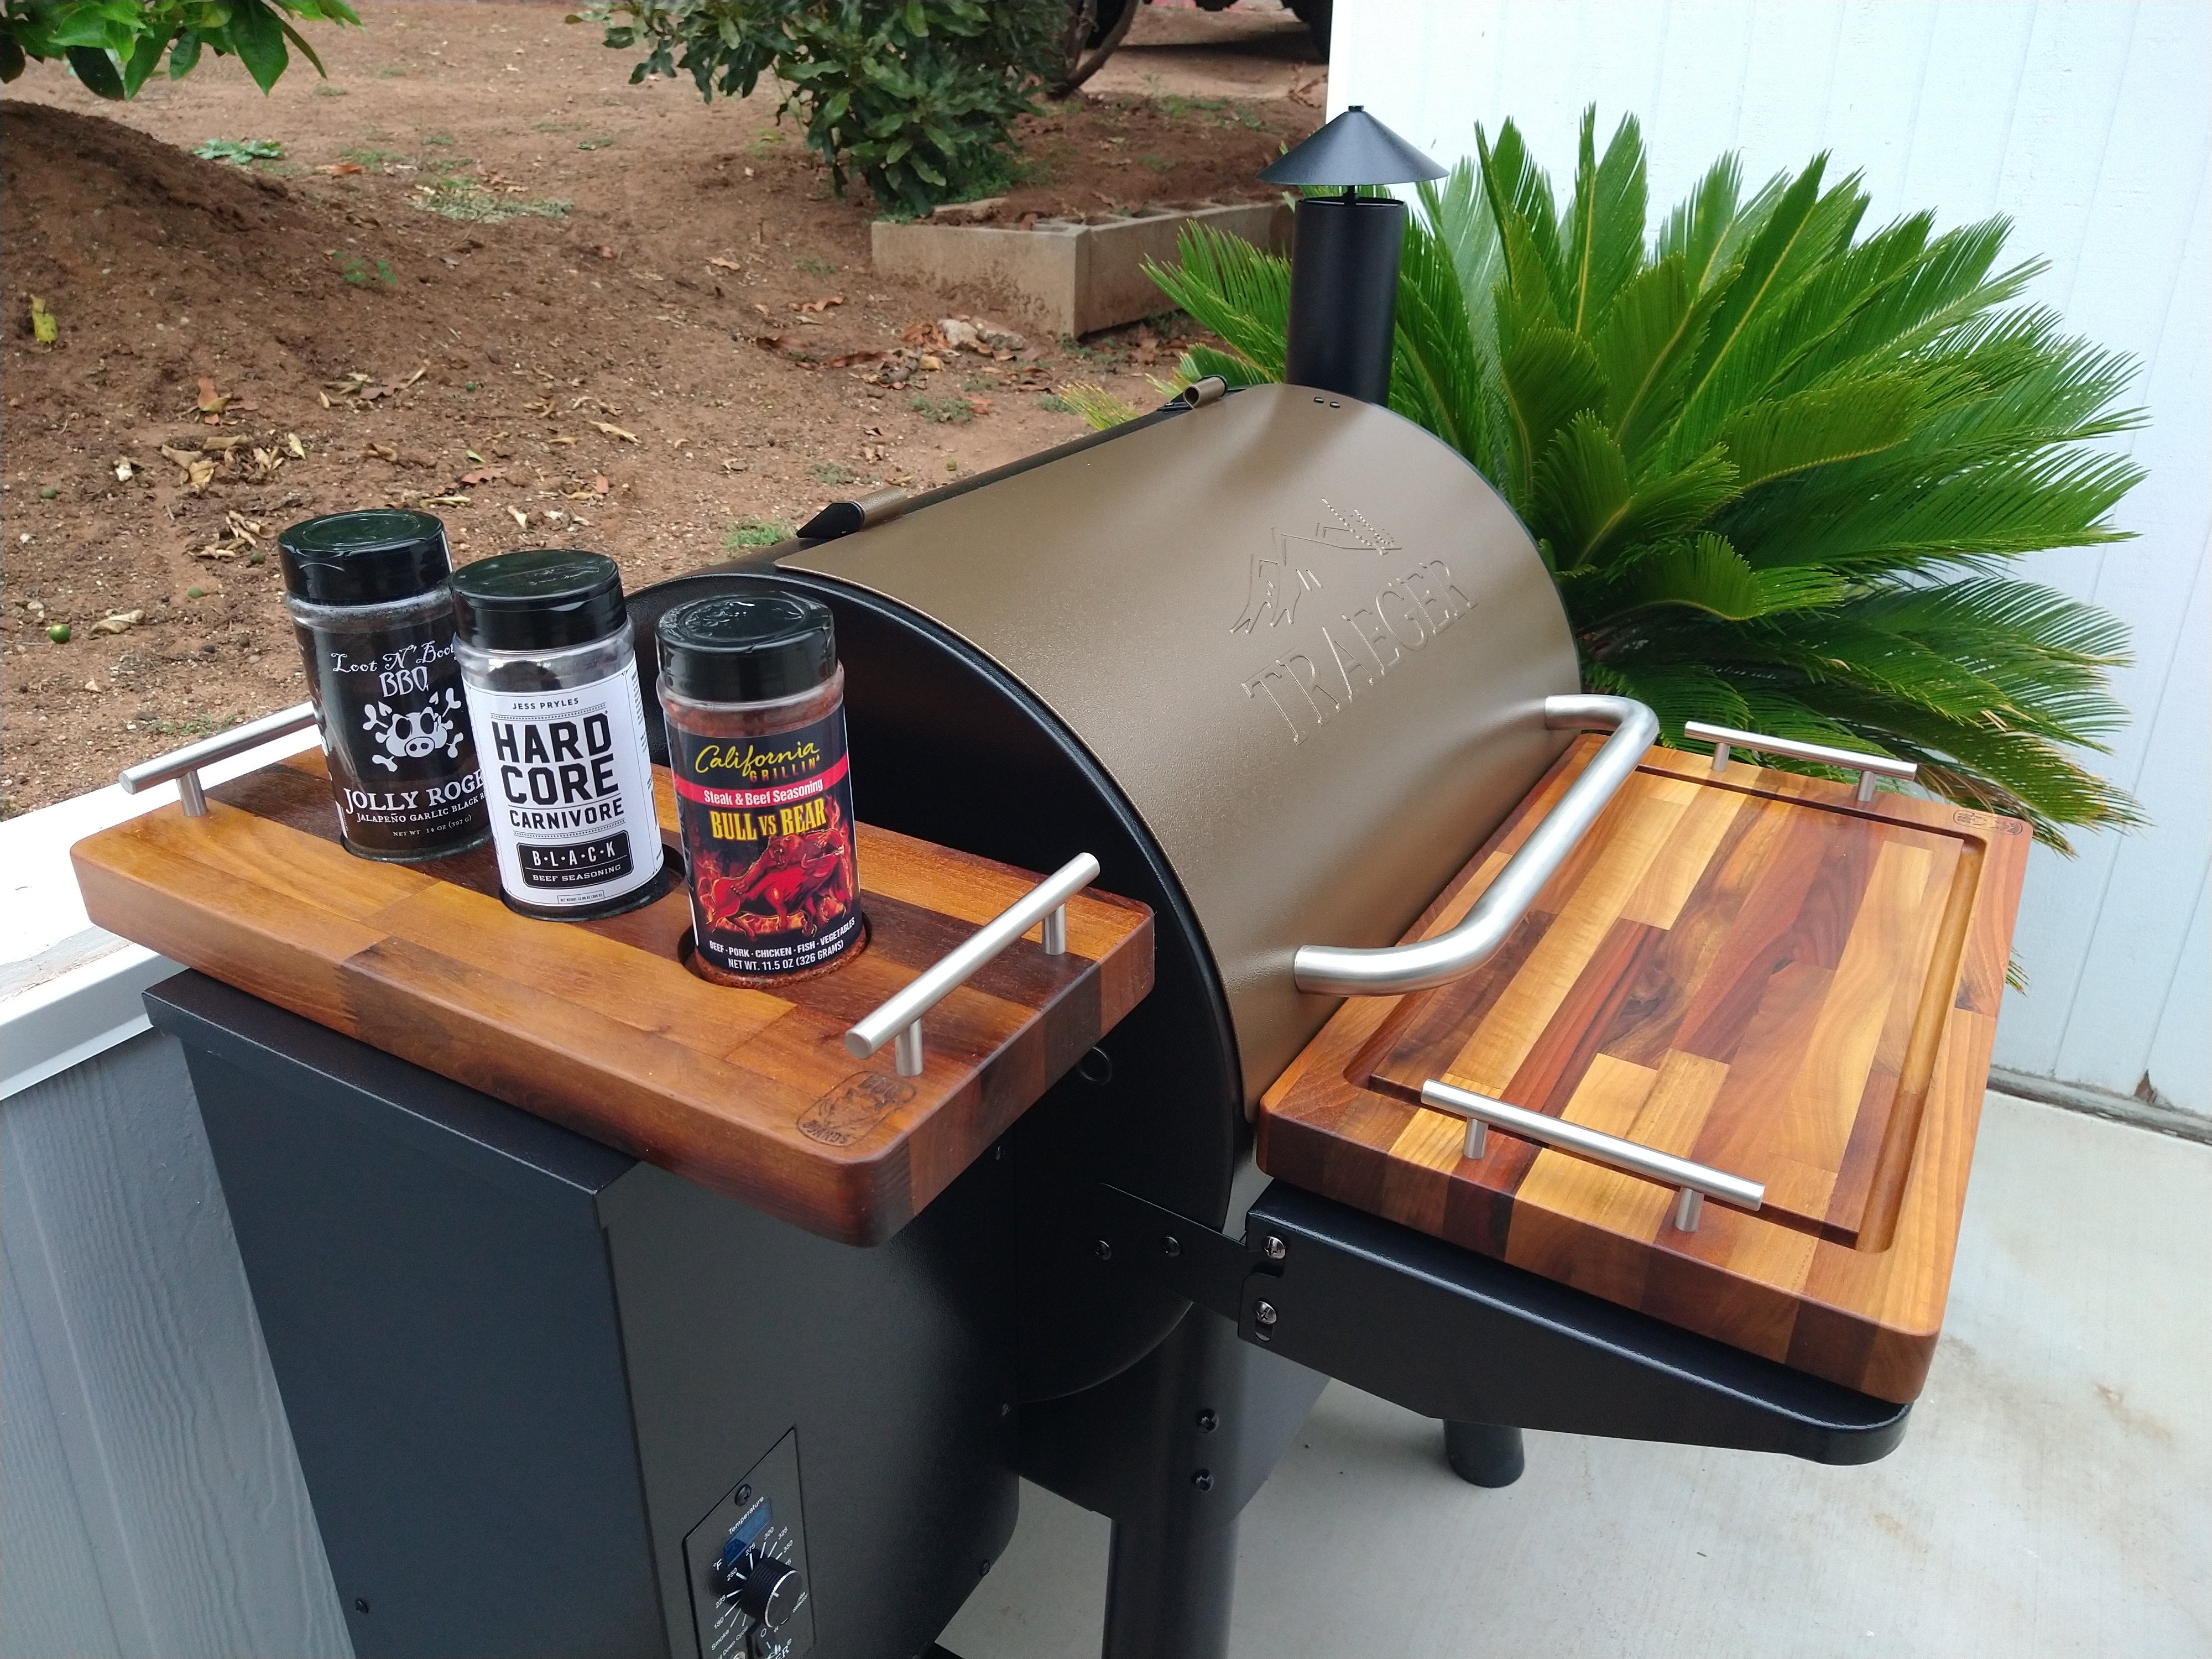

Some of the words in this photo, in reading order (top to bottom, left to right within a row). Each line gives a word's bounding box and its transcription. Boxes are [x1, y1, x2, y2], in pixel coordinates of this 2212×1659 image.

[331, 653, 377, 672] Loot
[416, 640, 458, 664] Boot
[1240, 559, 1478, 745] TRAEGER
[379, 666, 429, 697] BBQ
[540, 697, 579, 709] PRYLES
[491, 712, 612, 764] HARD
[695, 741, 820, 777] California
[343, 787, 419, 815] JOLLY
[426, 769, 484, 807] ROGE
[500, 753, 619, 805] CORE
[703, 790, 733, 806] Steak
[735, 793, 743, 806] &
[744, 790, 771, 806] Beef
[773, 779, 824, 802] Seasoning
[357, 812, 406, 823] JALAPEÑO
[409, 808, 449, 822] GARLIC
[452, 796, 479, 813] BLACK
[509, 797, 624, 830] CARNIVORE
[709, 811, 758, 841] BULL
[780, 797, 827, 836] BEAR
[448, 820, 463, 828] (397
[562, 864, 622, 882] SEASONING
[709, 940, 725, 953] BEEF
[728, 947, 750, 958] PORK
[755, 947, 792, 958] CHICKEN
[797, 941, 816, 953] FISH
[820, 917, 855, 946] VEGETABLES
[728, 958, 742, 968] NET
[744, 960, 760, 971] WT.
[761, 961, 781, 971] 11.5
[782, 958, 794, 969] OZ
[796, 953, 816, 967] (326
[817, 940, 844, 960] GRAMS)
[728, 1496, 765, 1535] Temperature
[764, 1526, 774, 1540] 300
[778, 1526, 788, 1540] 325
[783, 1540, 793, 1553] 350
[745, 1542, 755, 1557] 275
[727, 1567, 737, 1582] 250
[715, 1594, 727, 1609] 225
[713, 1616, 724, 1629] 180
[711, 1629, 730, 1651] Smoke
[723, 1640, 735, 1656] Down
